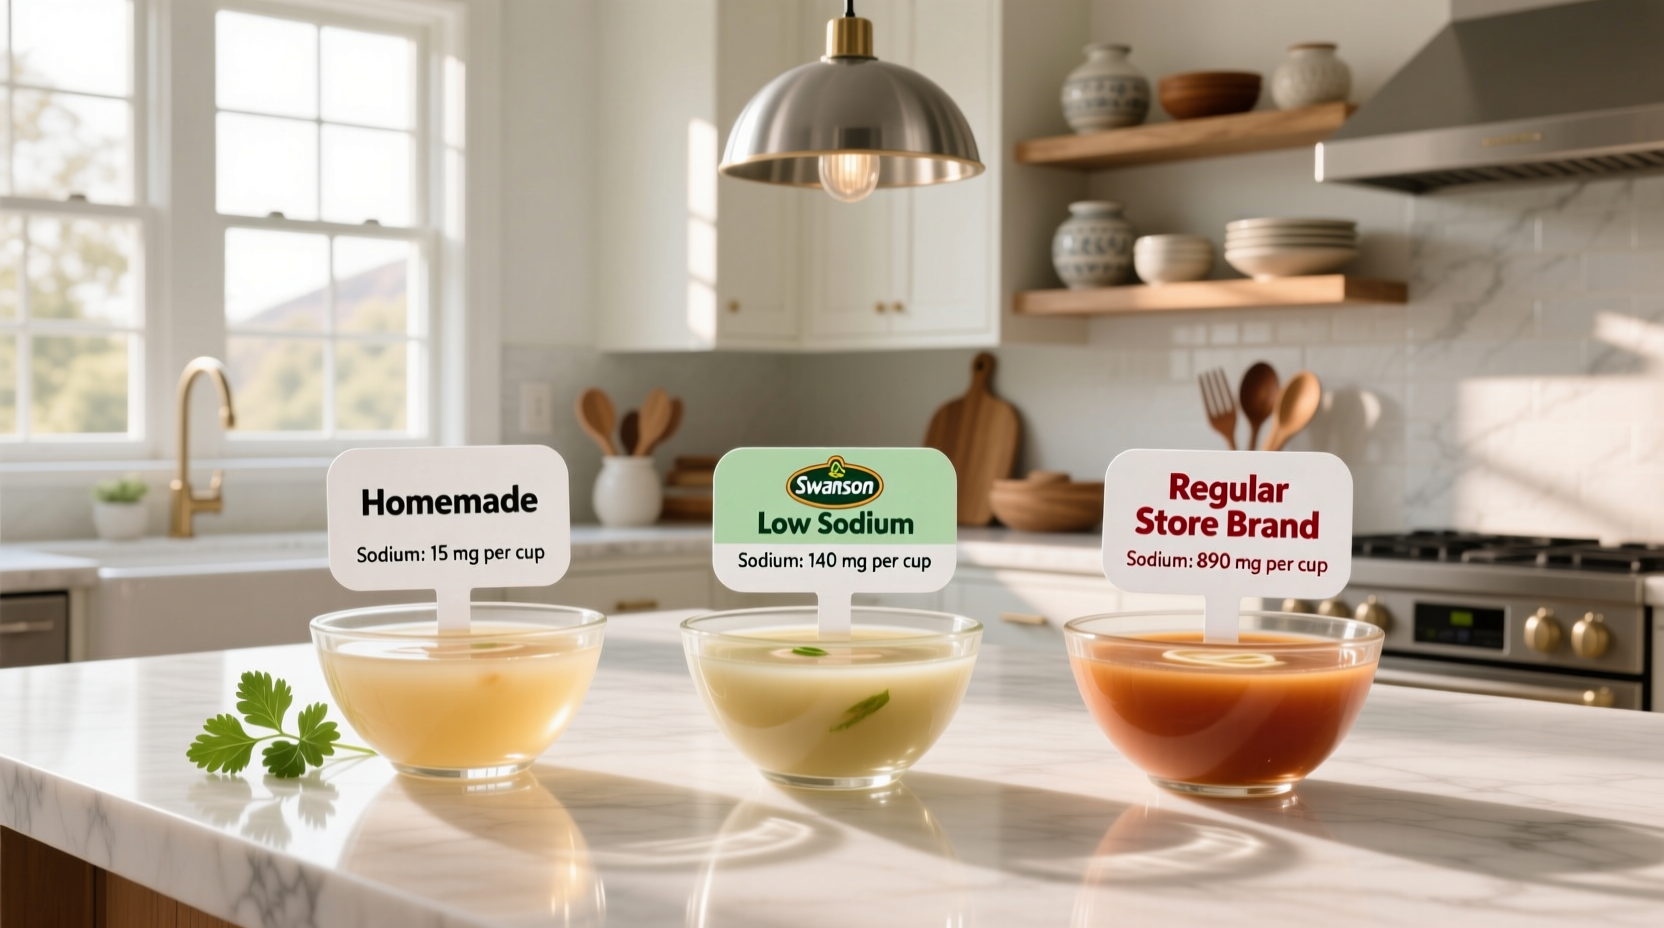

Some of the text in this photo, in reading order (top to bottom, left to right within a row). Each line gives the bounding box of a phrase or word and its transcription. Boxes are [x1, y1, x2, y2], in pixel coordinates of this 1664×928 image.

[795, 476, 874, 496] Swanson
[1169, 472, 1290, 510] Regular
[362, 484, 539, 516] Homemade
[758, 511, 914, 535] Low Sodium
[1135, 506, 1320, 540] Store Brand
[357, 544, 545, 565] Sodium: 15 mg per cup
[738, 551, 932, 573] Sodium: 140 mg per cup
[1126, 550, 1328, 577] Sodium: 890 mg per cup
